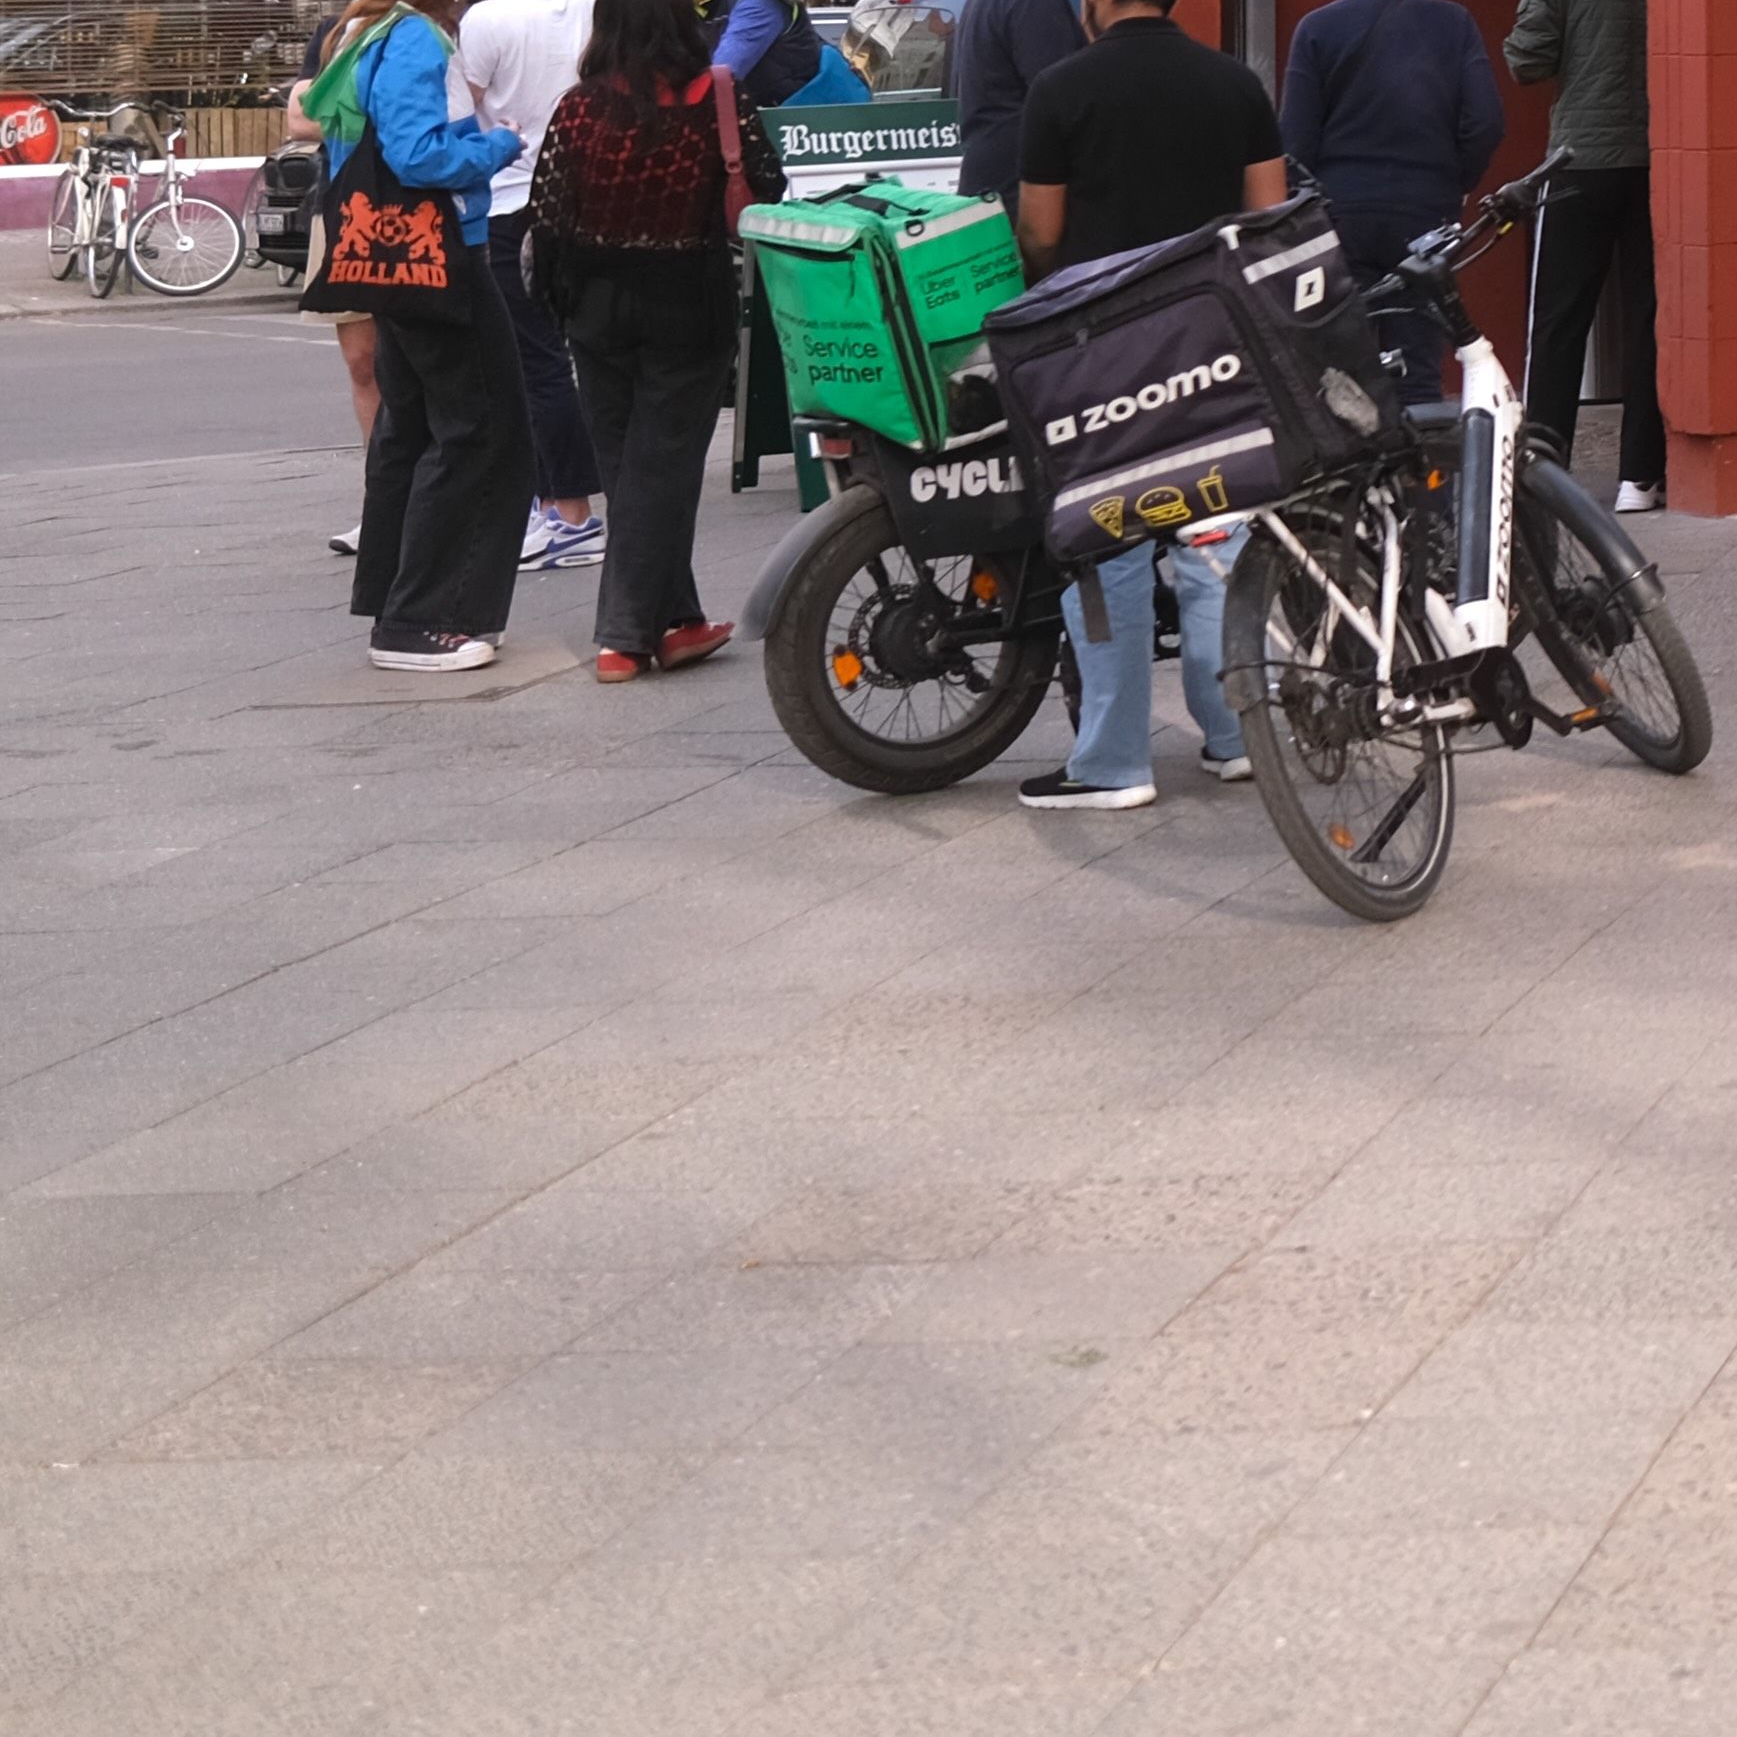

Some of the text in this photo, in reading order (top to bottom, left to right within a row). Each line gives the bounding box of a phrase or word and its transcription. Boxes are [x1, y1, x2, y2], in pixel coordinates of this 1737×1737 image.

[1, 104, 48, 149] Cola
[327, 260, 448, 288] HOLLAND
[803, 334, 879, 359] Service
[808, 363, 884, 386] partner
[1081, 353, 1242, 433] zoomo
